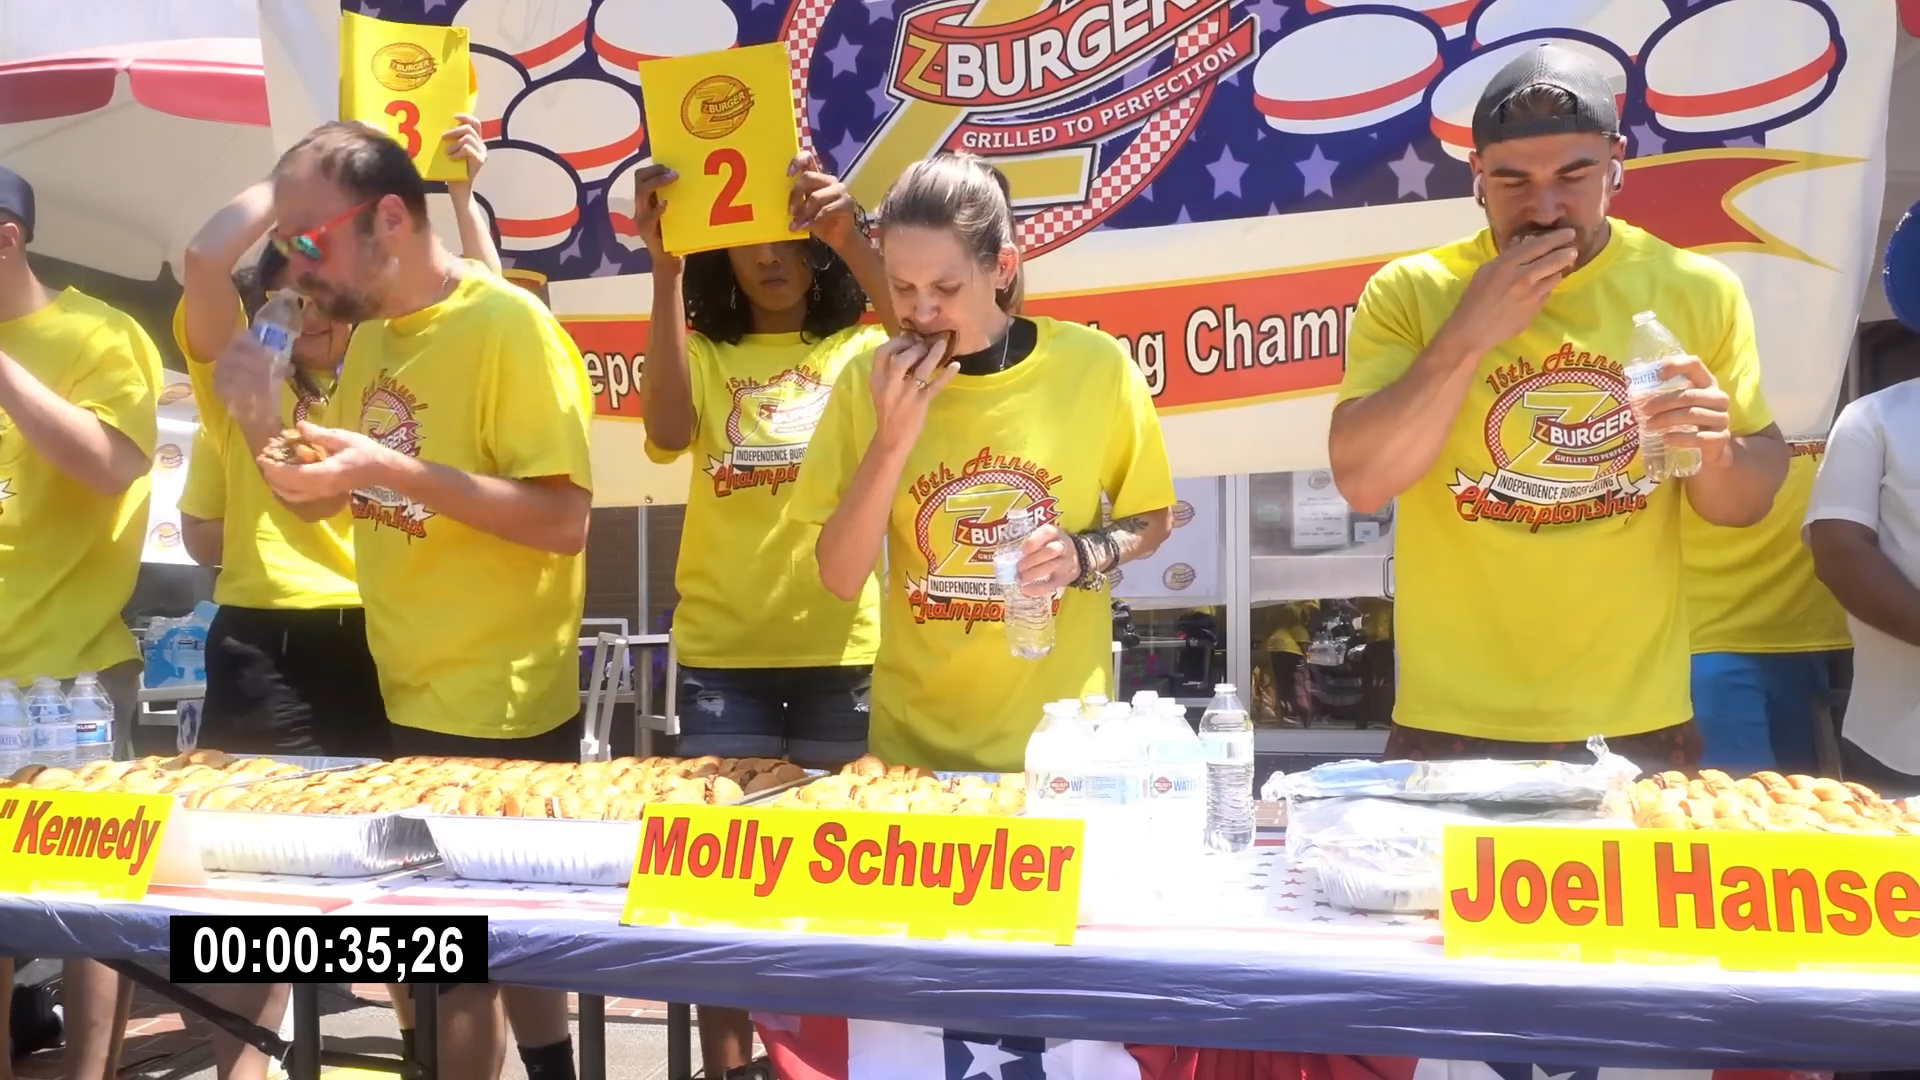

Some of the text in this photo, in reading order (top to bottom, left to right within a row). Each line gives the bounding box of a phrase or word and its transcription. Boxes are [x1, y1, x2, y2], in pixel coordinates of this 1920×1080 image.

[962, 41, 1238, 148] GRILLED TO PERFECTION
[384, 100, 422, 160] 3
[704, 148, 755, 227] 2
[1486, 356, 1534, 394] 15th
[1633, 373, 1657, 386] WATER
[1536, 408, 1635, 448] ZBURGER
[736, 447, 788, 462] INDEPENDENCE
[909, 446, 1063, 504] 15th Annual
[1554, 454, 1588, 463] GRILLED
[1588, 455, 1600, 463] TO
[1455, 484, 1648, 534] Championship
[1497, 473, 1559, 501] INDEPENDENCE
[930, 579, 988, 596] INDEPENDENCE
[13, 800, 161, 876] Kennedy
[637, 816, 1075, 906] Molly Schuyler
[1450, 836, 1625, 928] Joel
